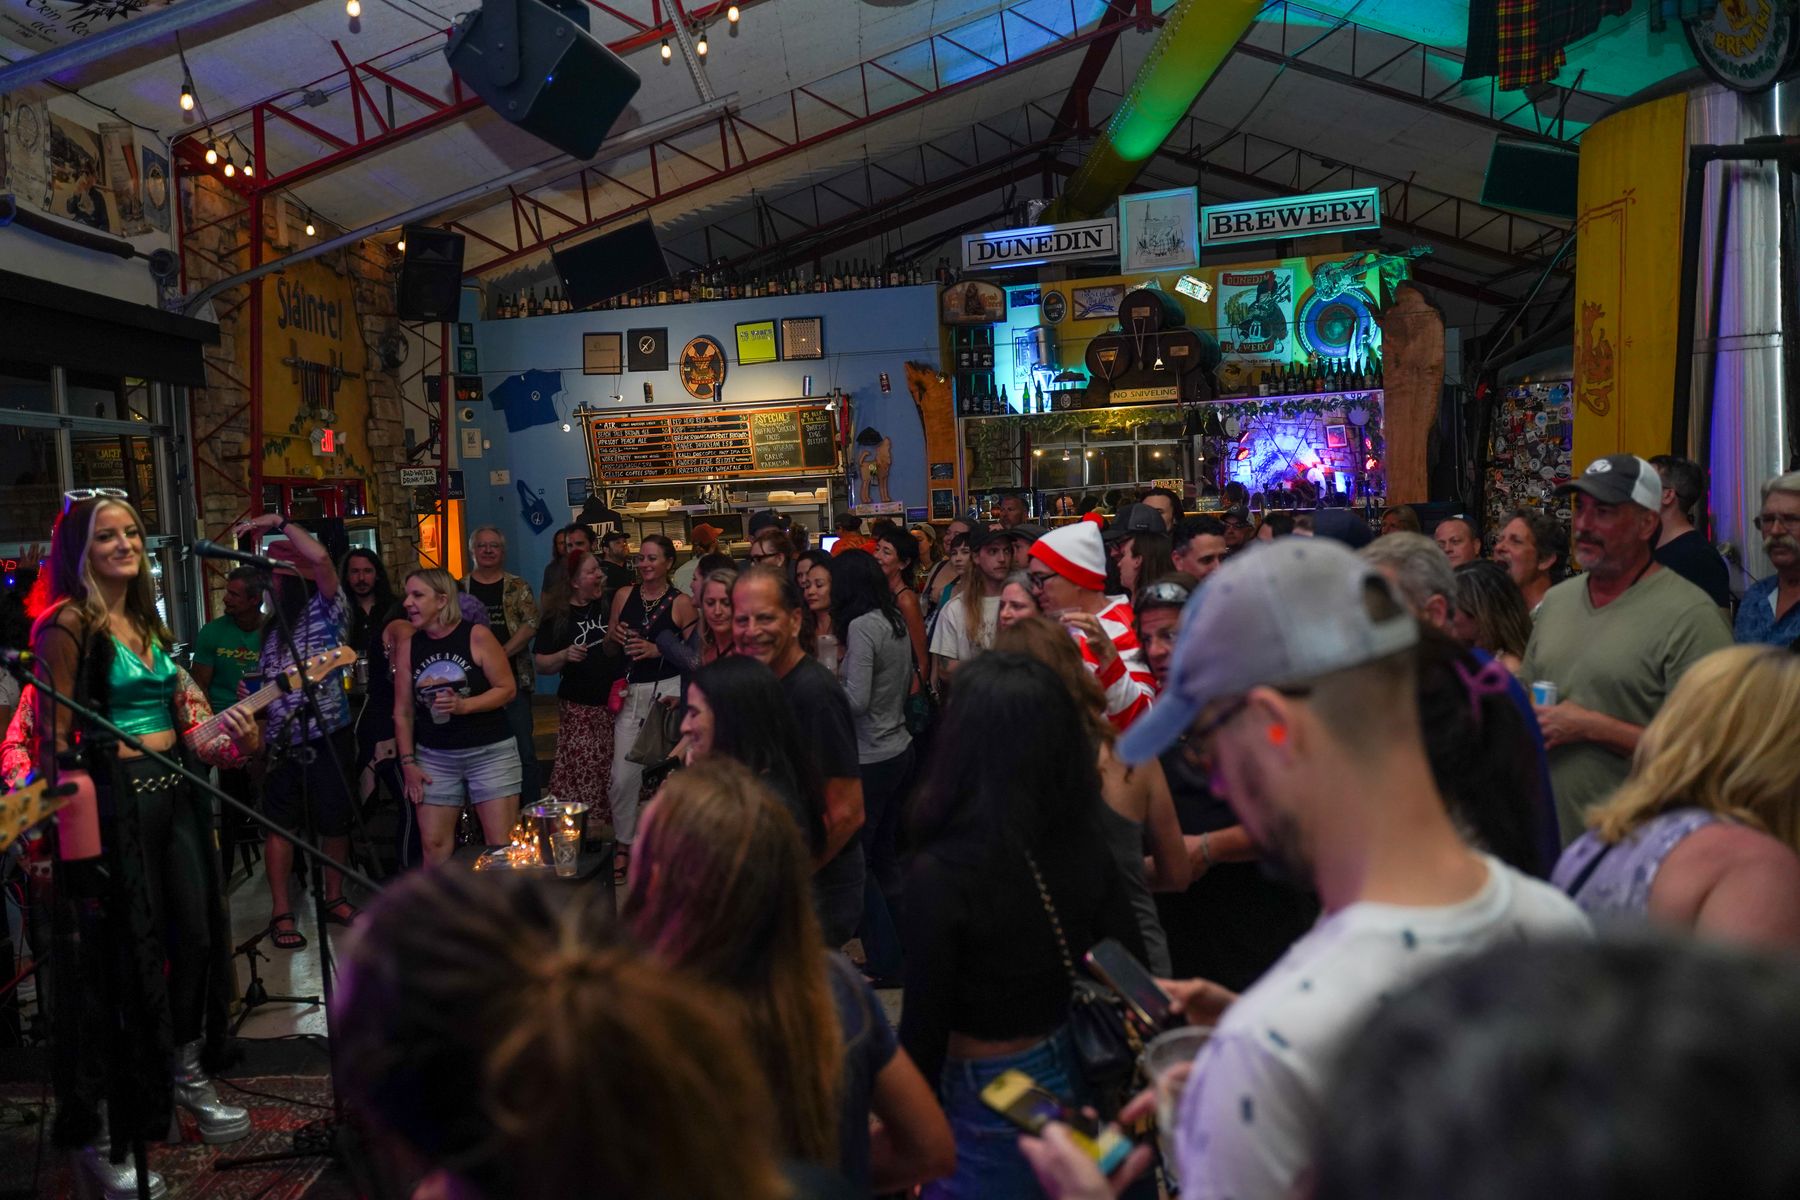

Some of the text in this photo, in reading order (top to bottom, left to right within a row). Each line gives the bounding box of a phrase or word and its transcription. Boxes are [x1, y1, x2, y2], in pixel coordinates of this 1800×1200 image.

[1212, 199, 1370, 236] BREWERY
[977, 228, 1103, 261] DUNEDIN
[1226, 273, 1270, 285] DUNEDIN
[1225, 342, 1271, 353] BWERY
[1113, 387, 1176, 399] NO SNIVELING
[420, 653, 442, 669] TAKE
[451, 653, 473, 672] HIKE
